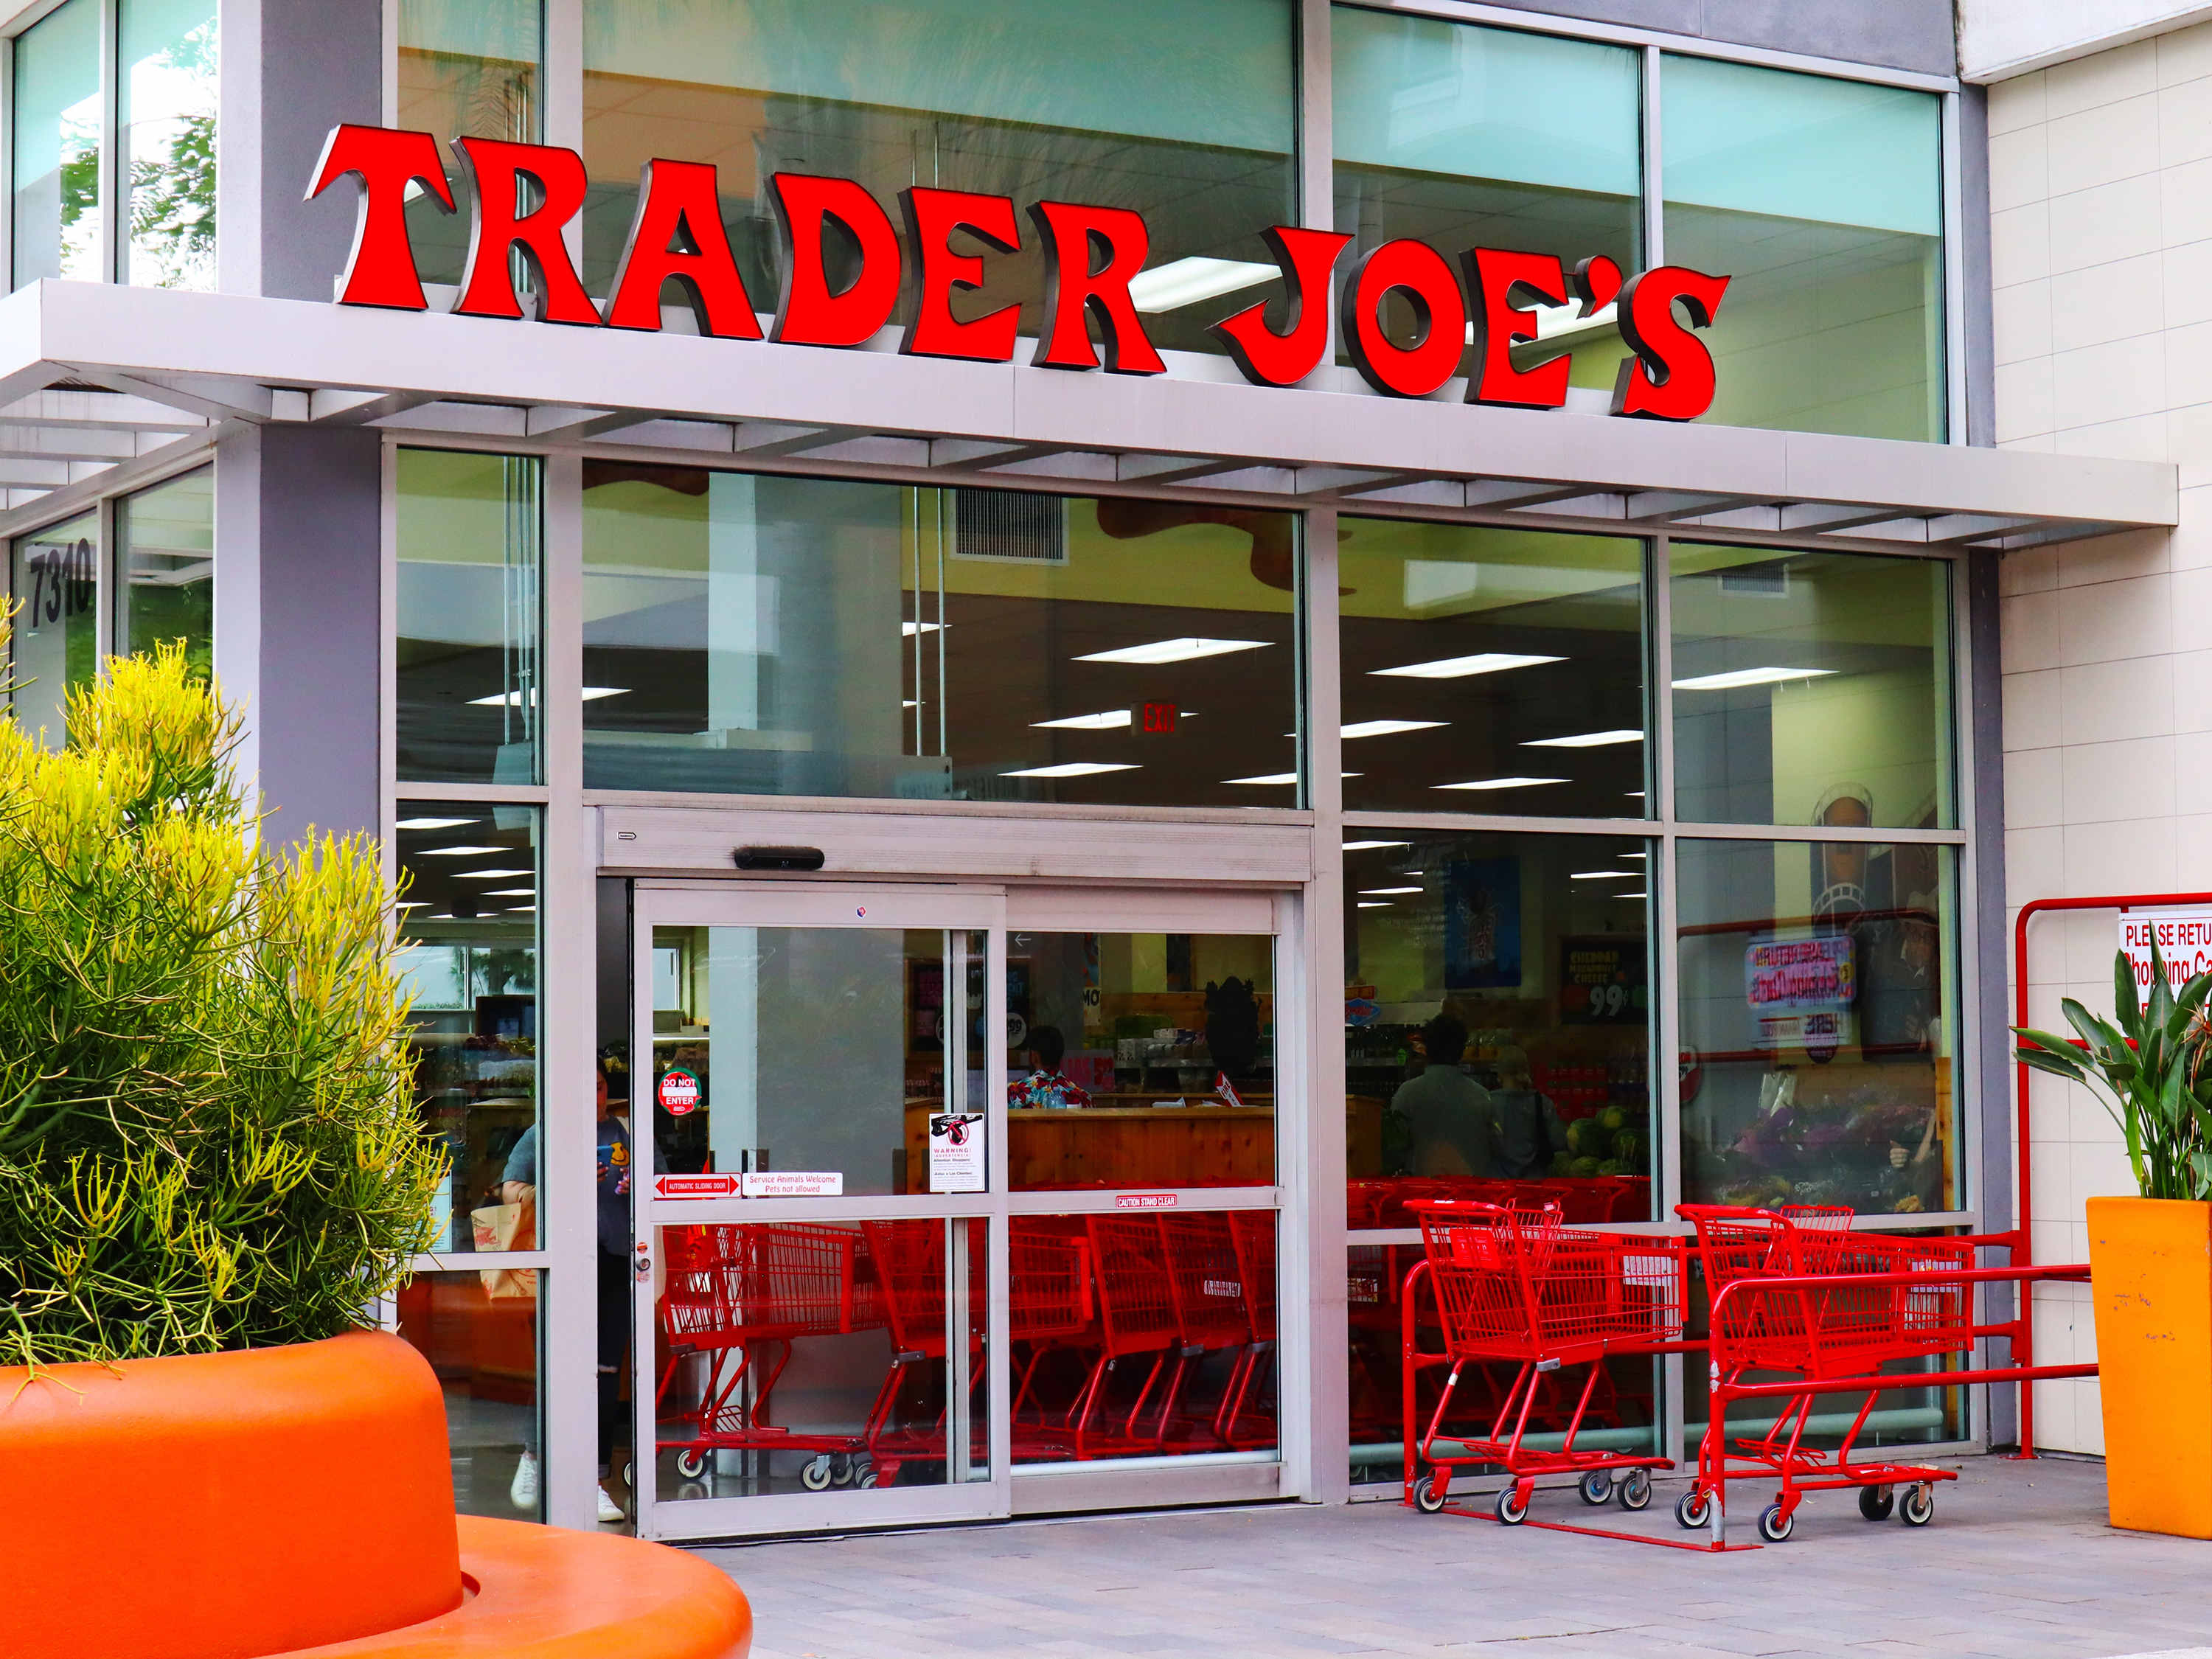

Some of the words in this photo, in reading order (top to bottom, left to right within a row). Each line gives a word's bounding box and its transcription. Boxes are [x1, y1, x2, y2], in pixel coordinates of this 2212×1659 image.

[303, 123, 1167, 375] TRADER
[1203, 225, 1731, 422] JOE'S
[30, 538, 91, 628] 7310
[1144, 703, 1177, 732] EXIT
[2126, 923, 2174, 947] PLESE
[664, 1079, 677, 1087] DO
[678, 1079, 695, 1087] NOT
[749, 1175, 775, 1183] Service
[777, 1175, 804, 1183] Animals
[806, 1174, 836, 1183] Welcome
[765, 1185, 780, 1193] Pets
[782, 1185, 793, 1193] not
[795, 1185, 821, 1193] allowed
[1118, 1198, 1140, 1207] CAUTION
[1141, 1197, 1158, 1206] STAND
[1158, 1197, 1175, 1206] CLEAR
